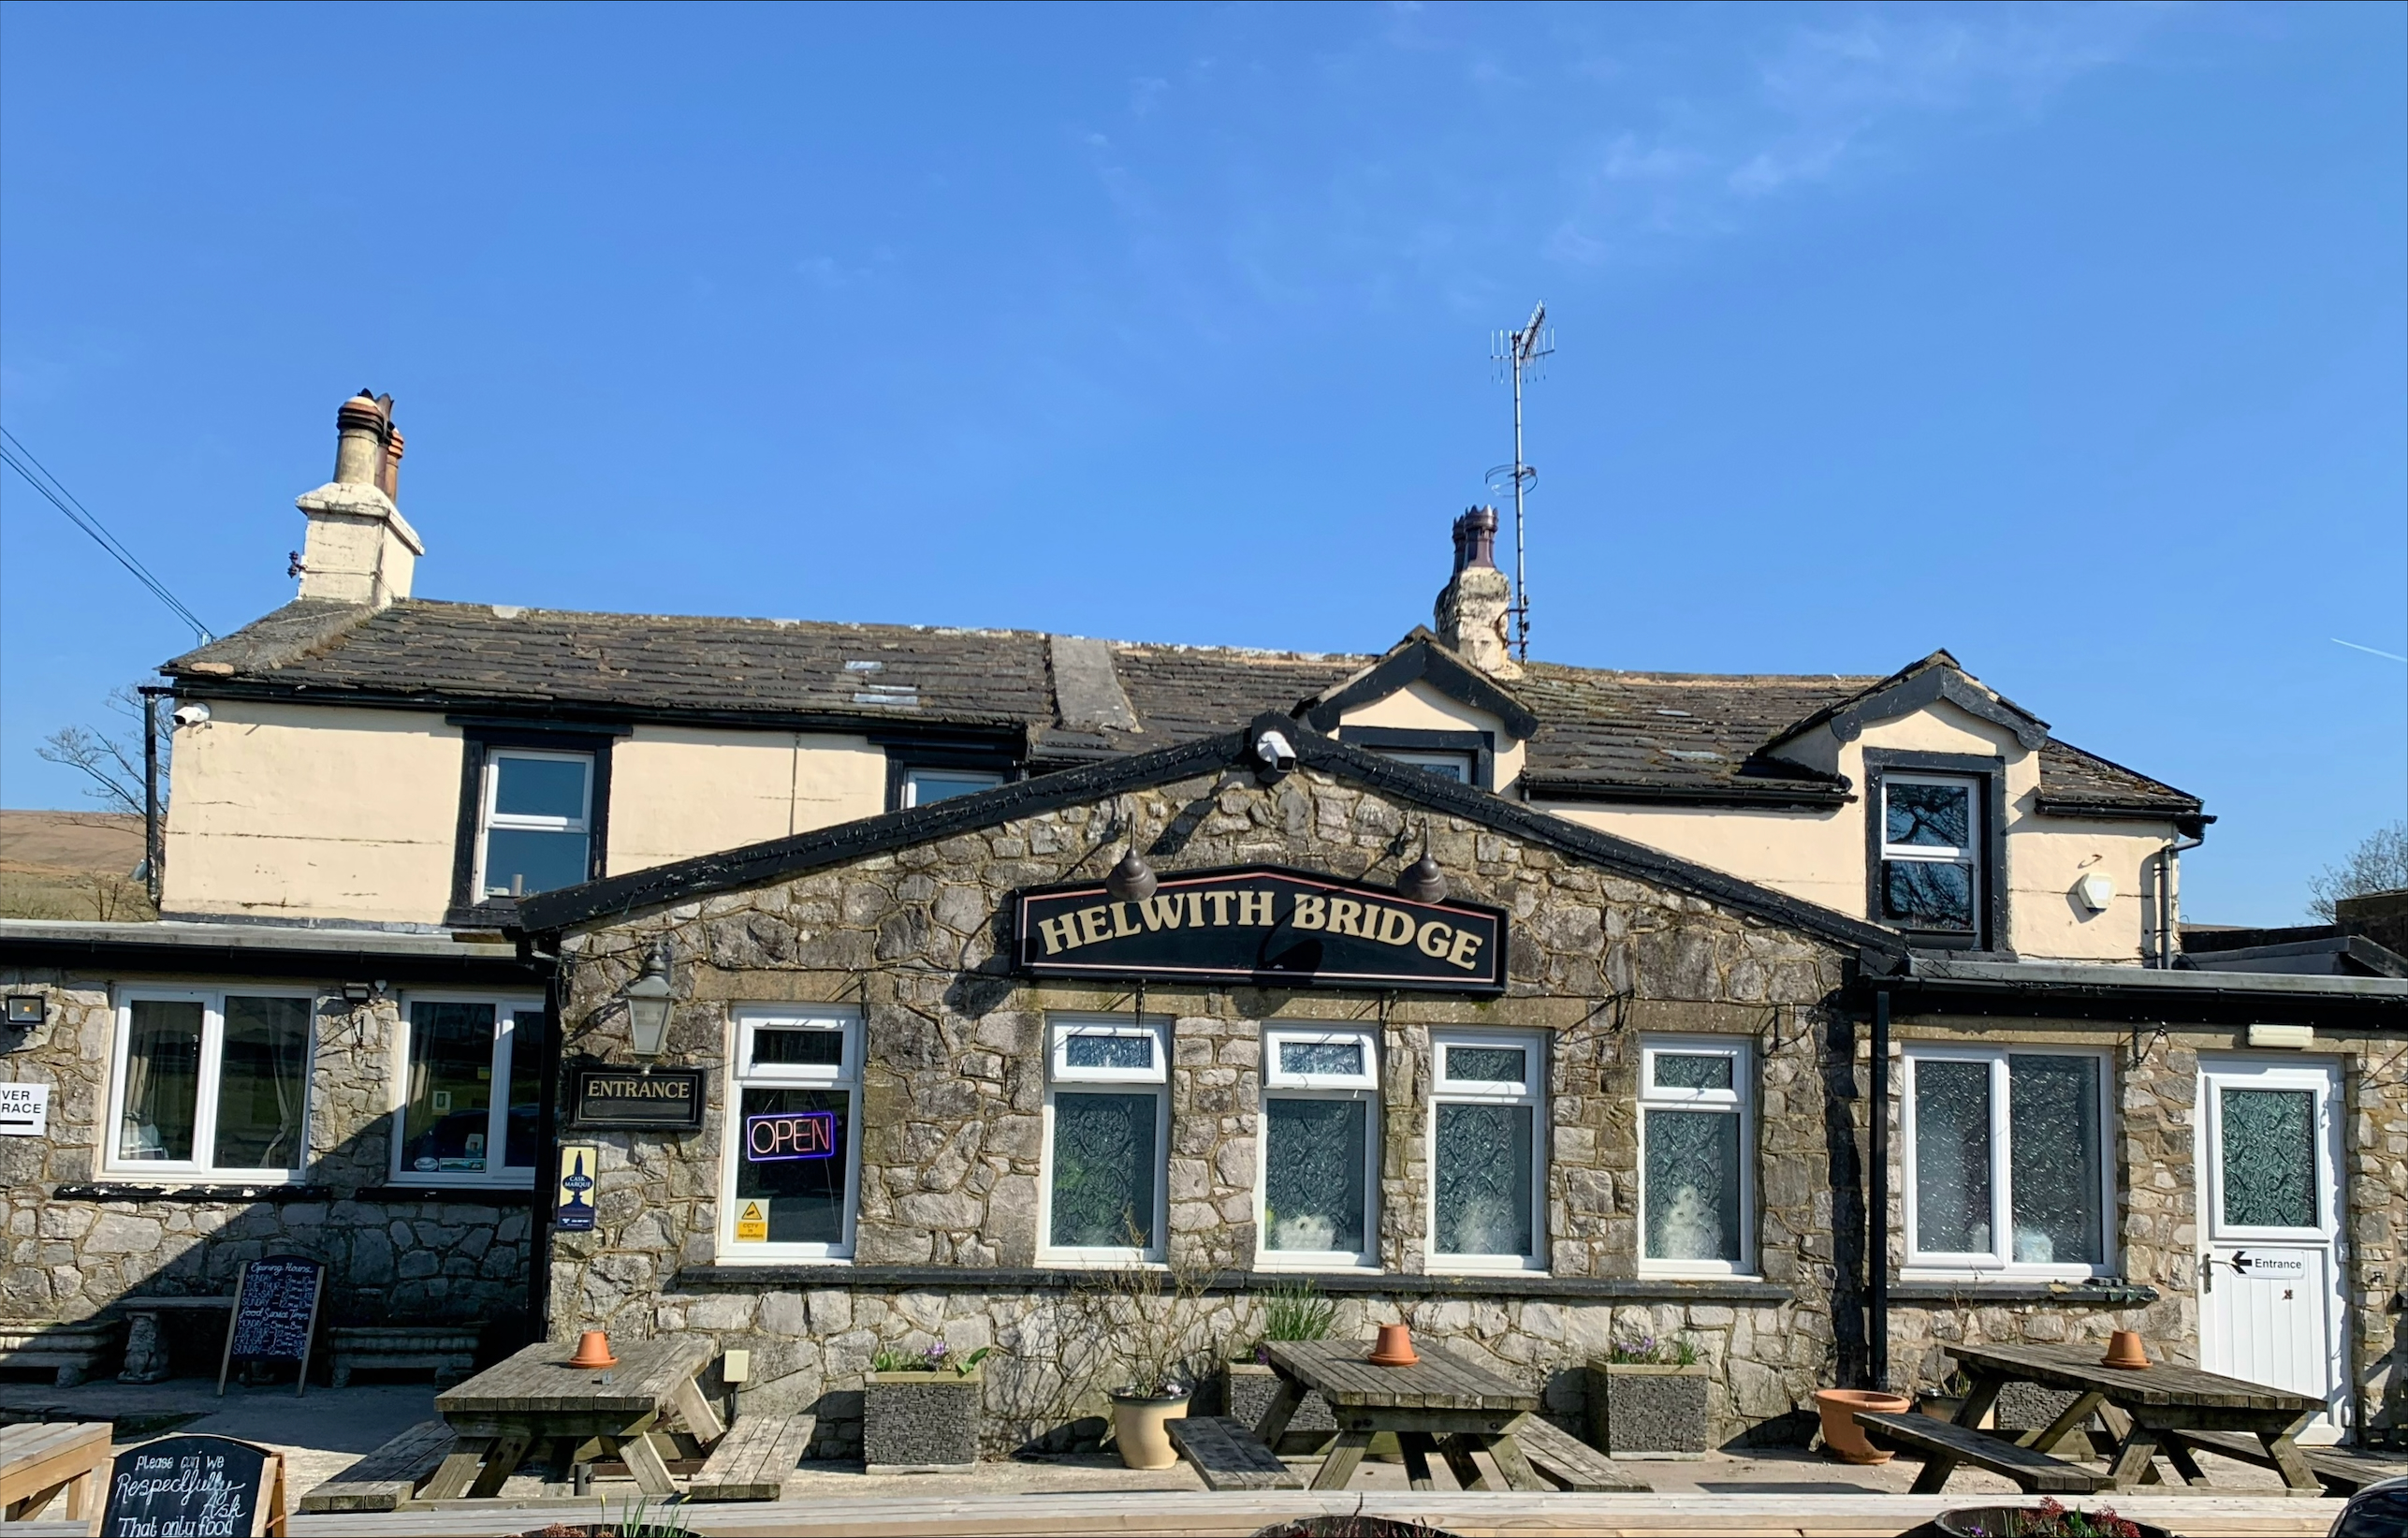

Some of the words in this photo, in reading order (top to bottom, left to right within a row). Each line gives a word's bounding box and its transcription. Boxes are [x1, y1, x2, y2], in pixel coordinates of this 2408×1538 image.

[1038, 890, 1275, 955] HELWITH
[1292, 893, 1482, 971] BRIDGE
[588, 1080, 690, 1099] ENTRANCE
[751, 1118, 830, 1153] OPEN
[250, 1261, 284, 1276] Opening
[285, 1262, 314, 1273] Hours
[2255, 1258, 2302, 1269] Entrance
[245, 1273, 273, 1282] MONDAY
[241, 1297, 270, 1307] SUNDAY
[115, 1470, 246, 1506] Respectfully
[199, 1493, 247, 1519] Ask
[118, 1516, 157, 1538] That
[197, 1516, 234, 1538] food
